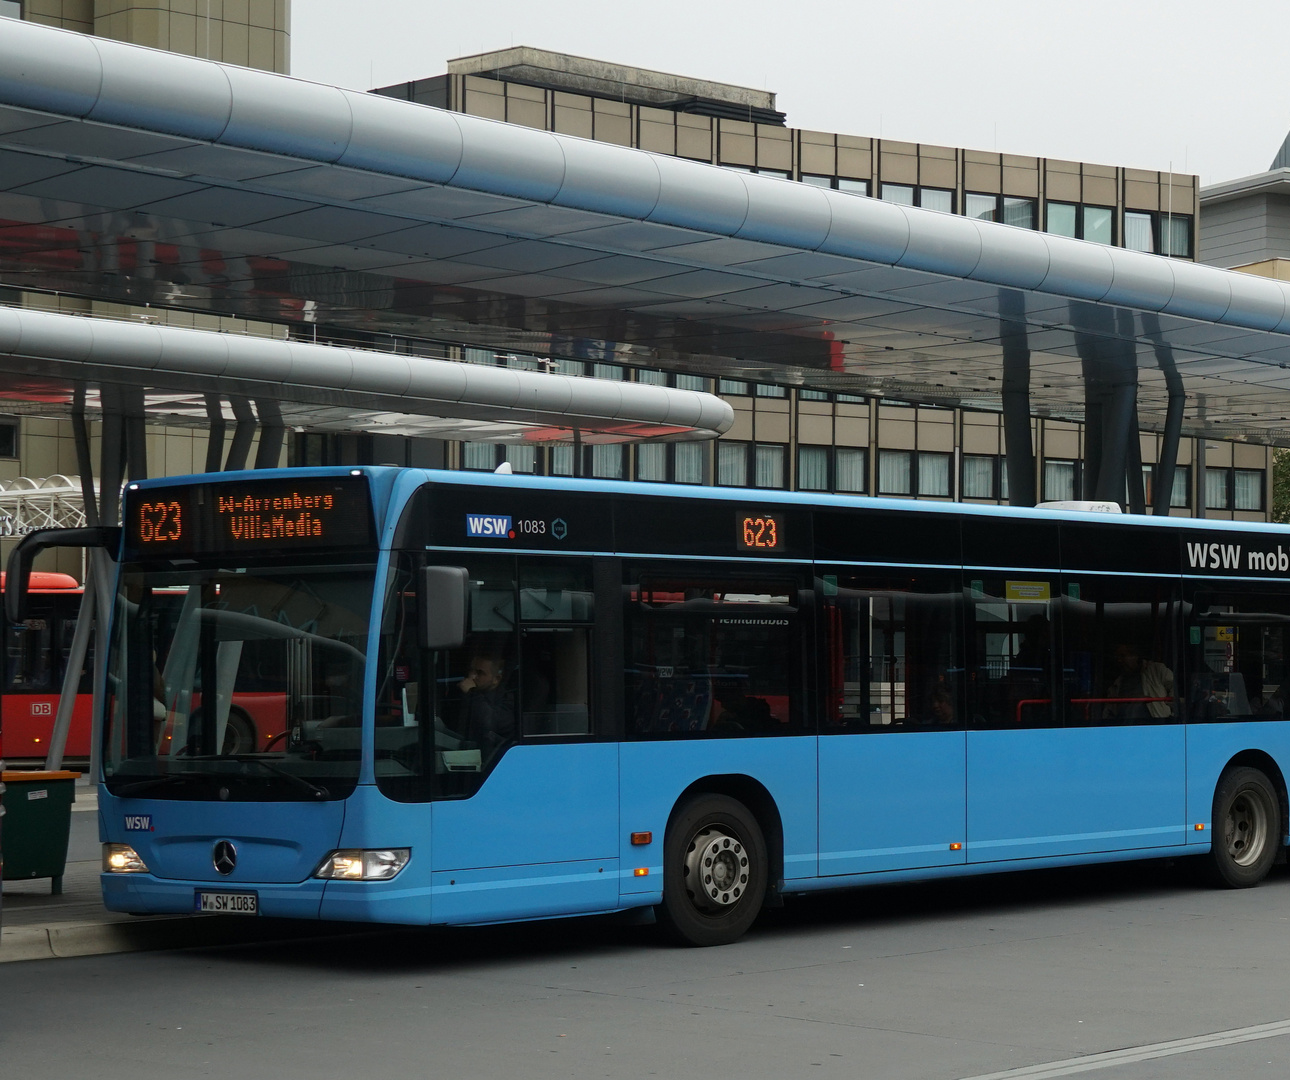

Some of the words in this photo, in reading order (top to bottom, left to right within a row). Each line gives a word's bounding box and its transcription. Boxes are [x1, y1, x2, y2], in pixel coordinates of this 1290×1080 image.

[219, 492, 333, 513] W-Arrenberg
[140, 501, 182, 541] 623
[231, 512, 322, 539] VillaMedia
[469, 517, 508, 535] WSW
[517, 519, 546, 534] 1083
[743, 517, 777, 547] 623
[1187, 542, 1241, 569] WSW
[33, 704, 50, 714] DB
[125, 816, 150, 830] WSW
[202, 895, 209, 909] W
[215, 895, 228, 910] SW
[230, 896, 255, 911] 1083
